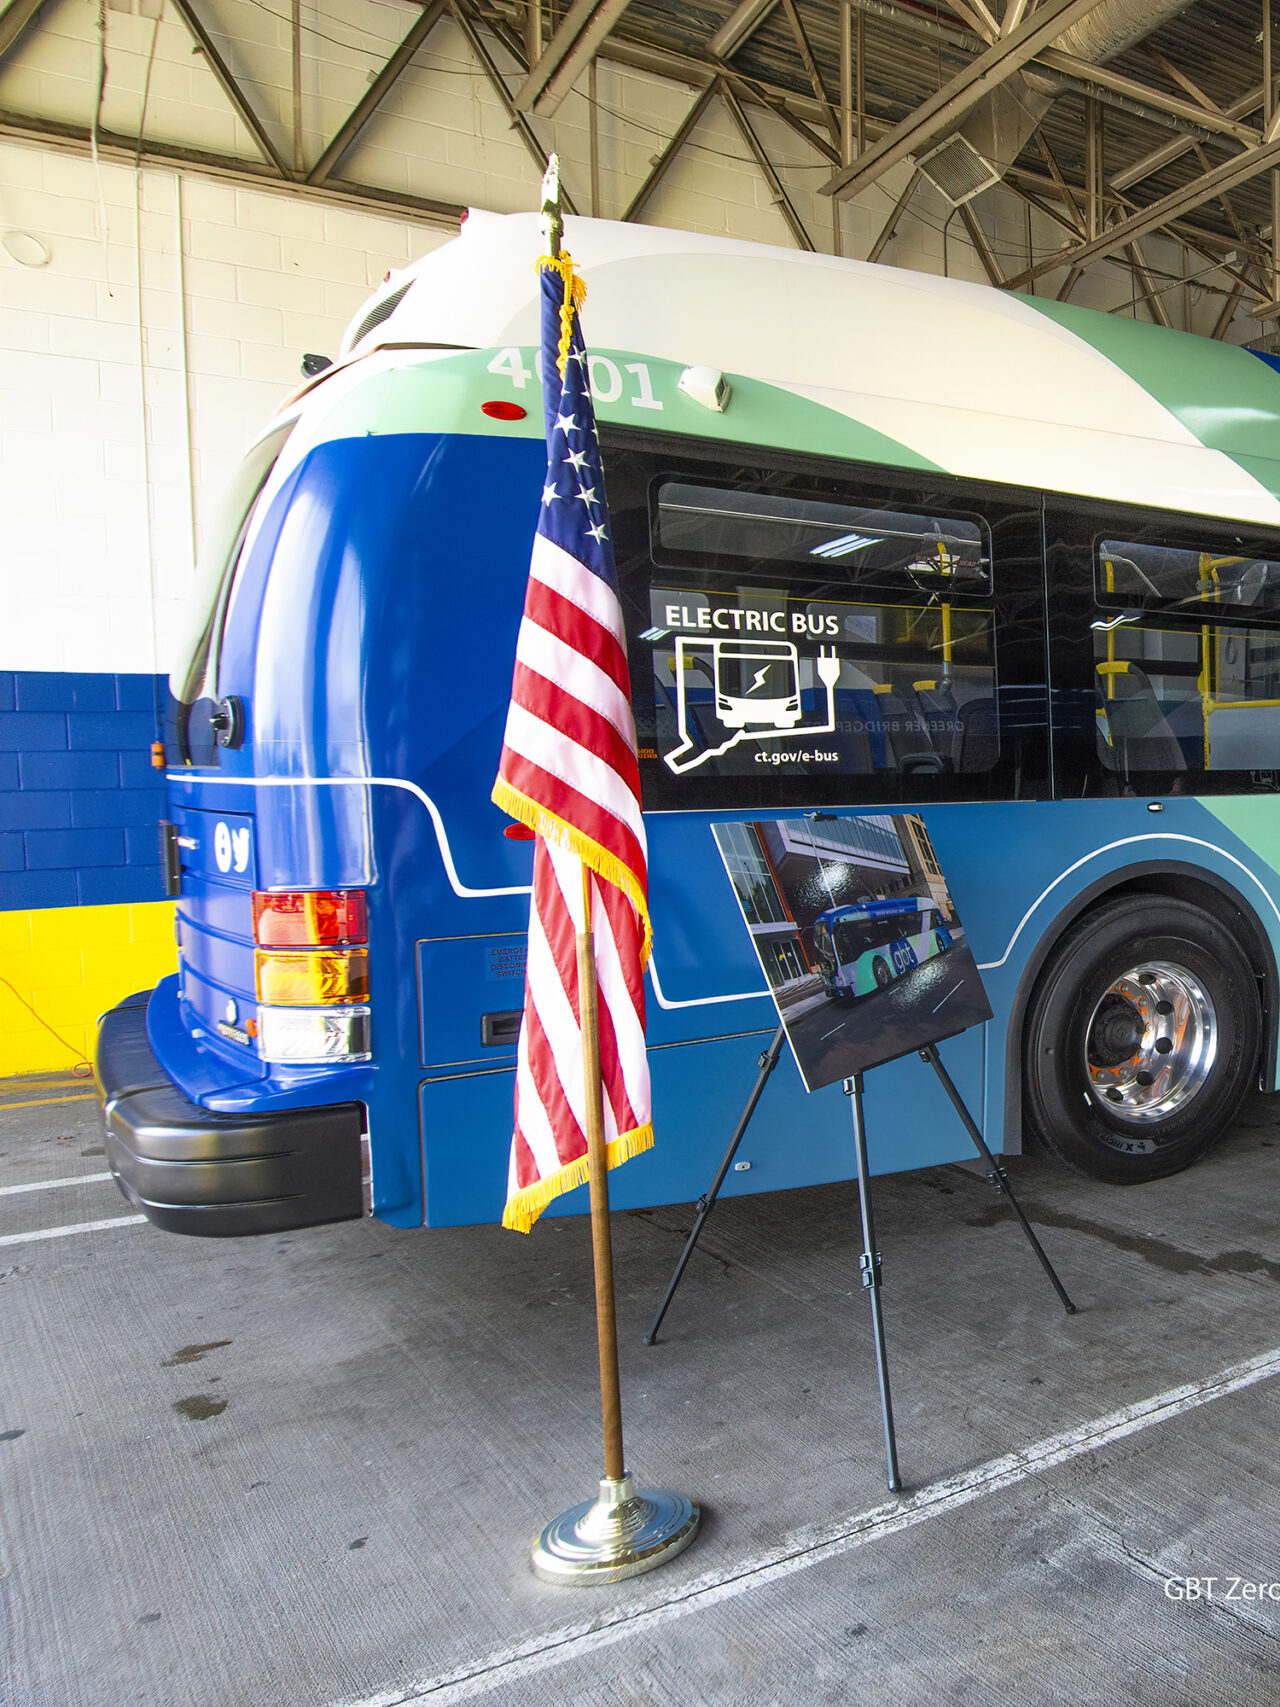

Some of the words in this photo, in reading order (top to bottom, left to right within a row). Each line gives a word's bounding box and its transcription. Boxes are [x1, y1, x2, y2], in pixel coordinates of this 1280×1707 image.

[487, 347, 664, 411] 401
[665, 604, 785, 633] ELECTRIC
[791, 612, 840, 636] BUS
[754, 749, 839, 765] ct.gov/e-bus
